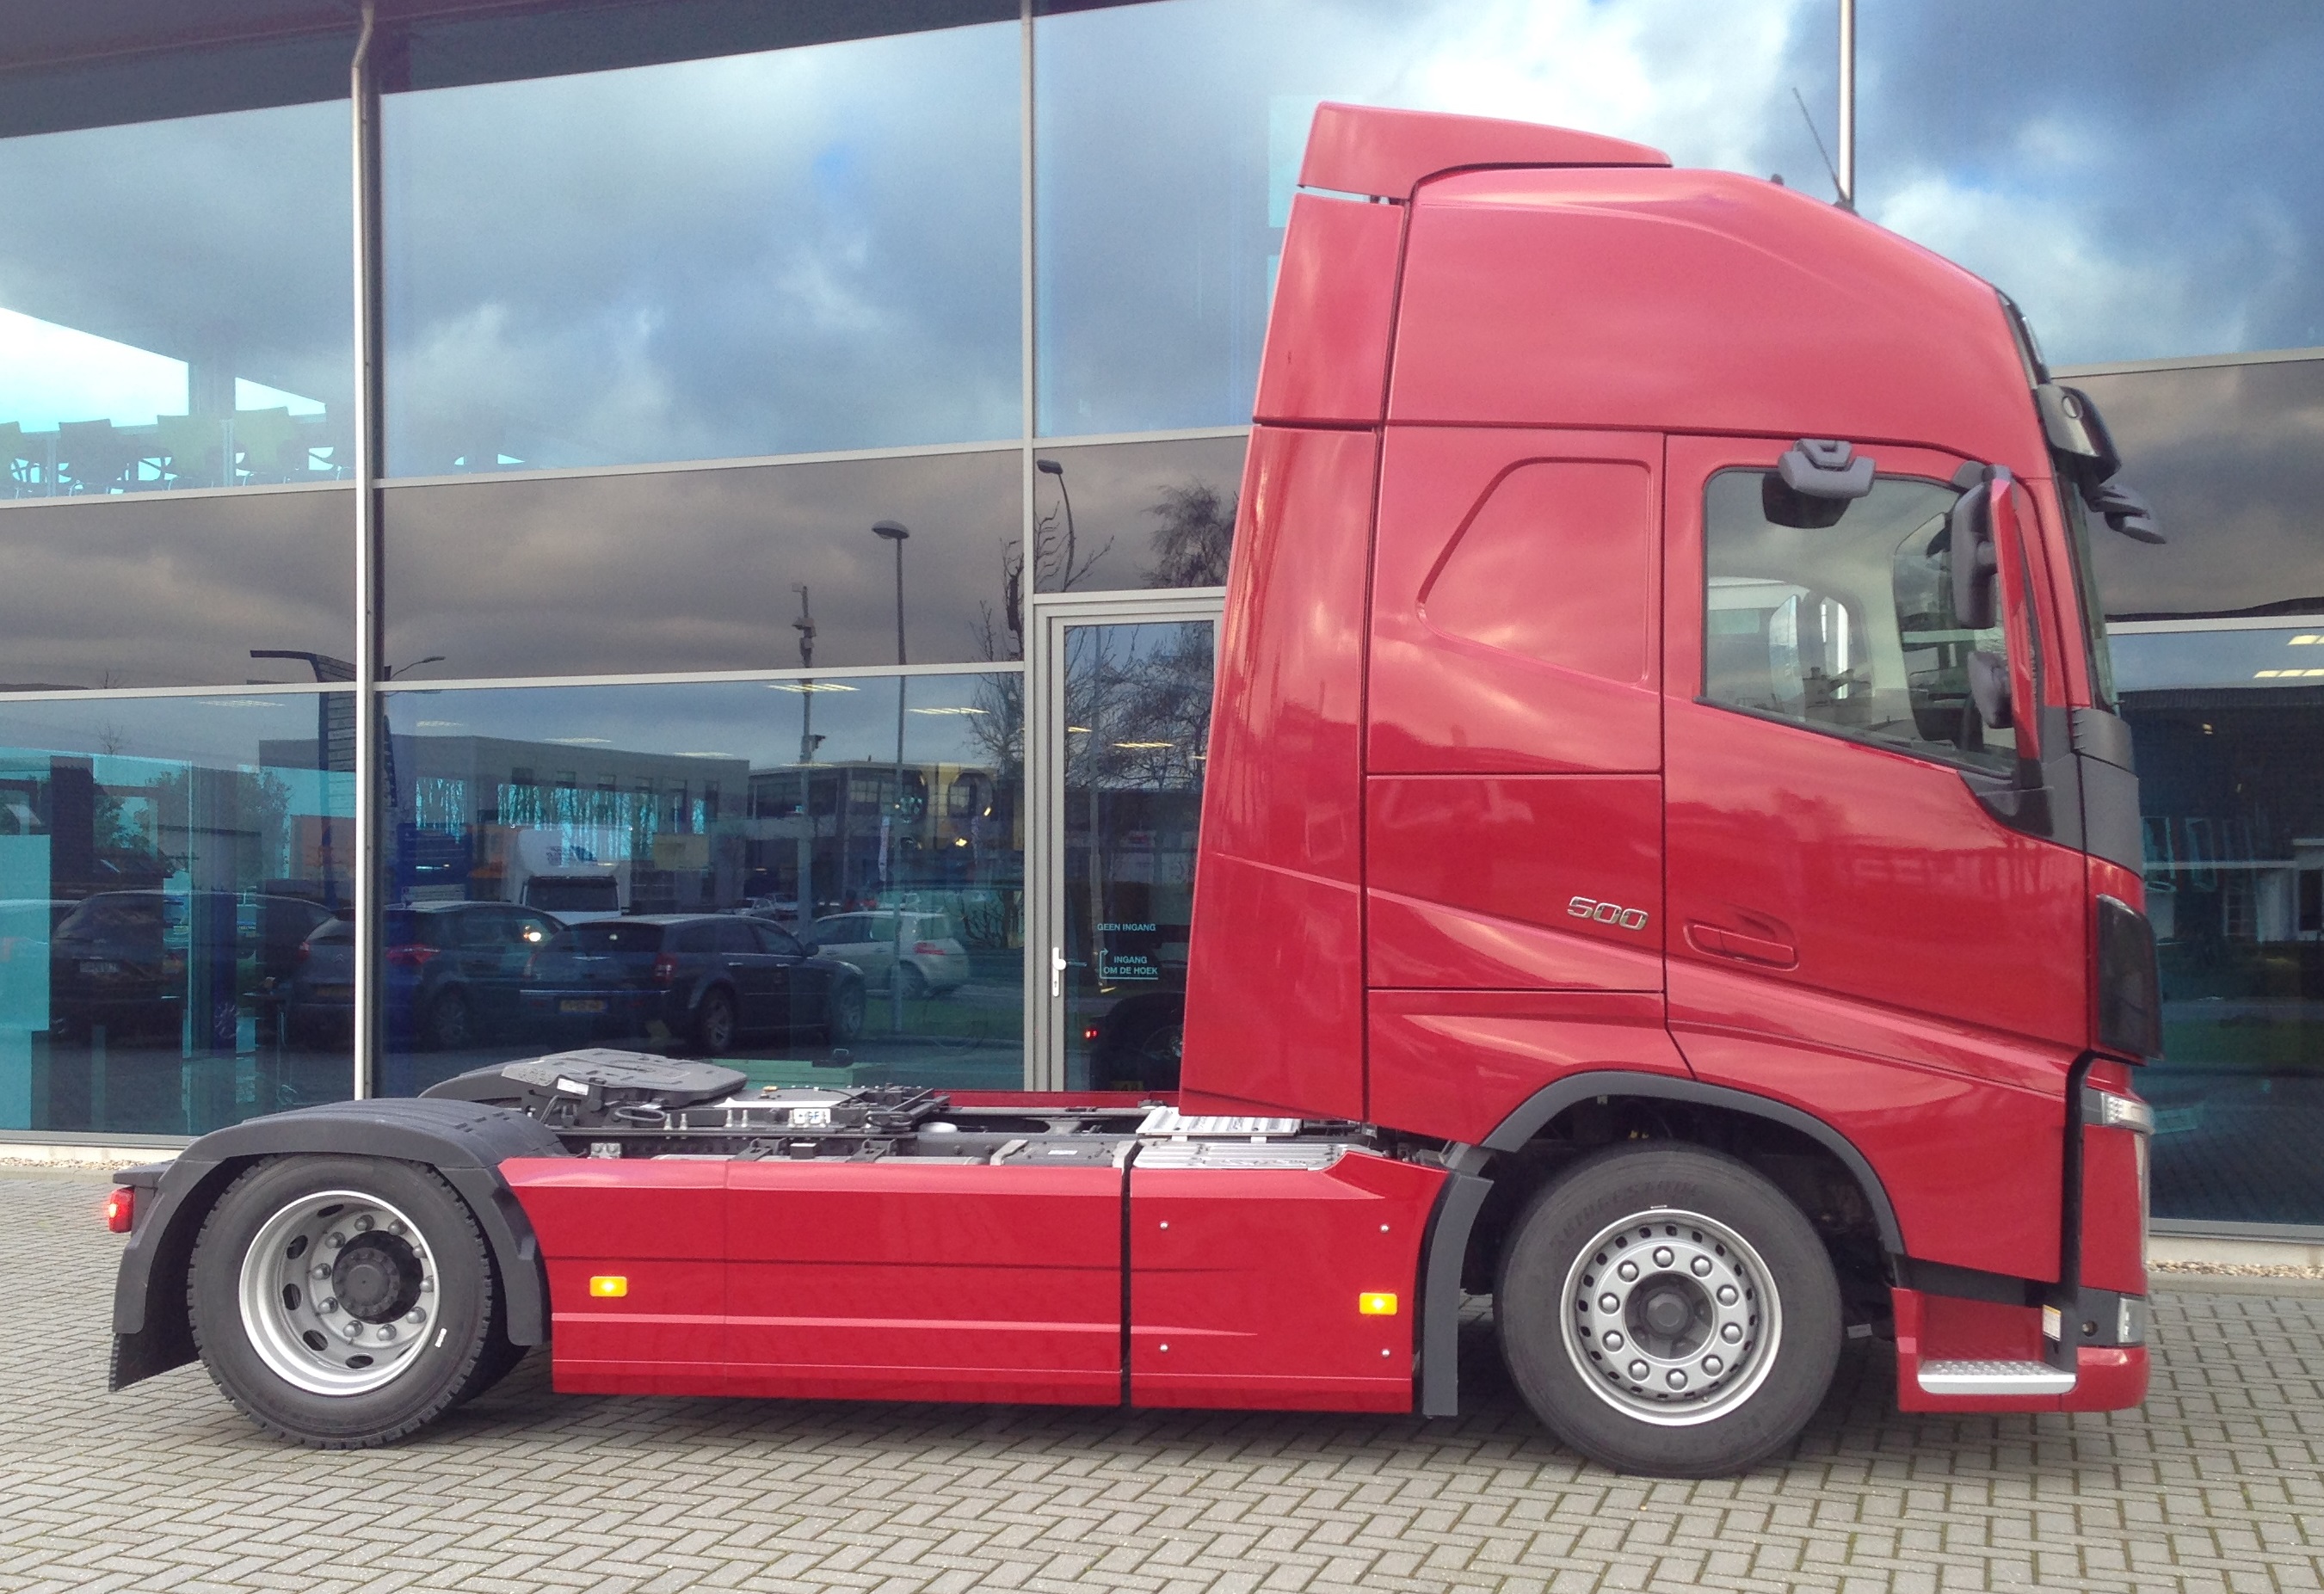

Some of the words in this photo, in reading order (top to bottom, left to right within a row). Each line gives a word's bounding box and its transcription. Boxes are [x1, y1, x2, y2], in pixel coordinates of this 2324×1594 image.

[1567, 895, 1649, 931] 500
[1097, 923, 1120, 932] GEEN
[1122, 923, 1156, 932] INGANG
[1113, 956, 1148, 964] INGANG
